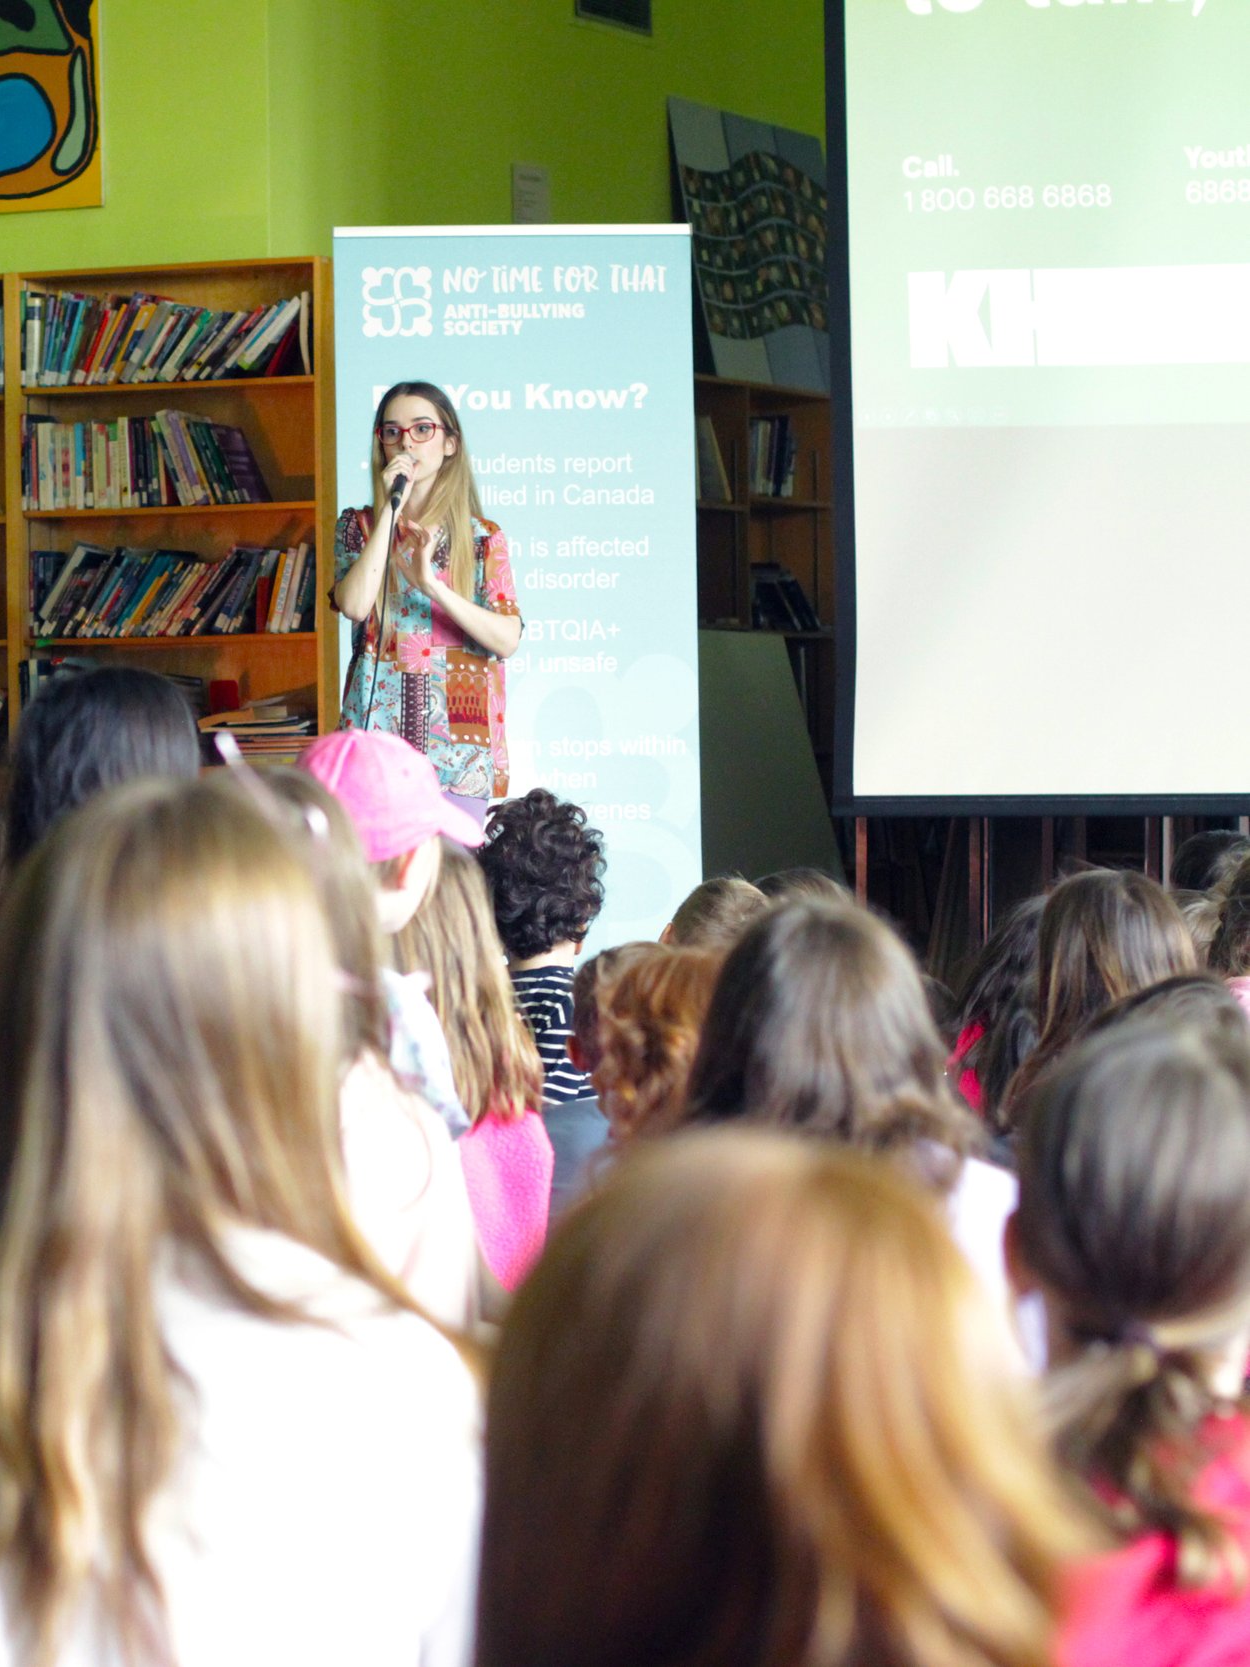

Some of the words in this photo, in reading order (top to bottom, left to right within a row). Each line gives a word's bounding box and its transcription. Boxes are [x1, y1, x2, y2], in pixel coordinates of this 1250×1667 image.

[902, 153, 960, 179] Call.
[983, 185, 1035, 209] 668
[1042, 183, 1112, 208] 6868
[442, 265, 485, 294] NO
[553, 265, 599, 294] FOR
[609, 264, 667, 294] THAT
[444, 303, 585, 320] ANTI-BULLYING
[443, 320, 524, 336] SOCIETY
[442, 383, 512, 411] You
[524, 382, 649, 411] Know?
[469, 453, 556, 474] tudents
[564, 454, 633, 478] report
[478, 484, 527, 506] llied
[535, 485, 555, 506] in
[563, 484, 655, 506] Canada
[530, 536, 550, 557] is
[556, 535, 650, 557] affected
[525, 568, 620, 589] disorder
[521, 620, 621, 642] BTQIA+
[539, 651, 618, 673] unsafe
[549, 736, 612, 760] stops
[619, 735, 687, 757] within
[586, 804, 652, 821] venes
